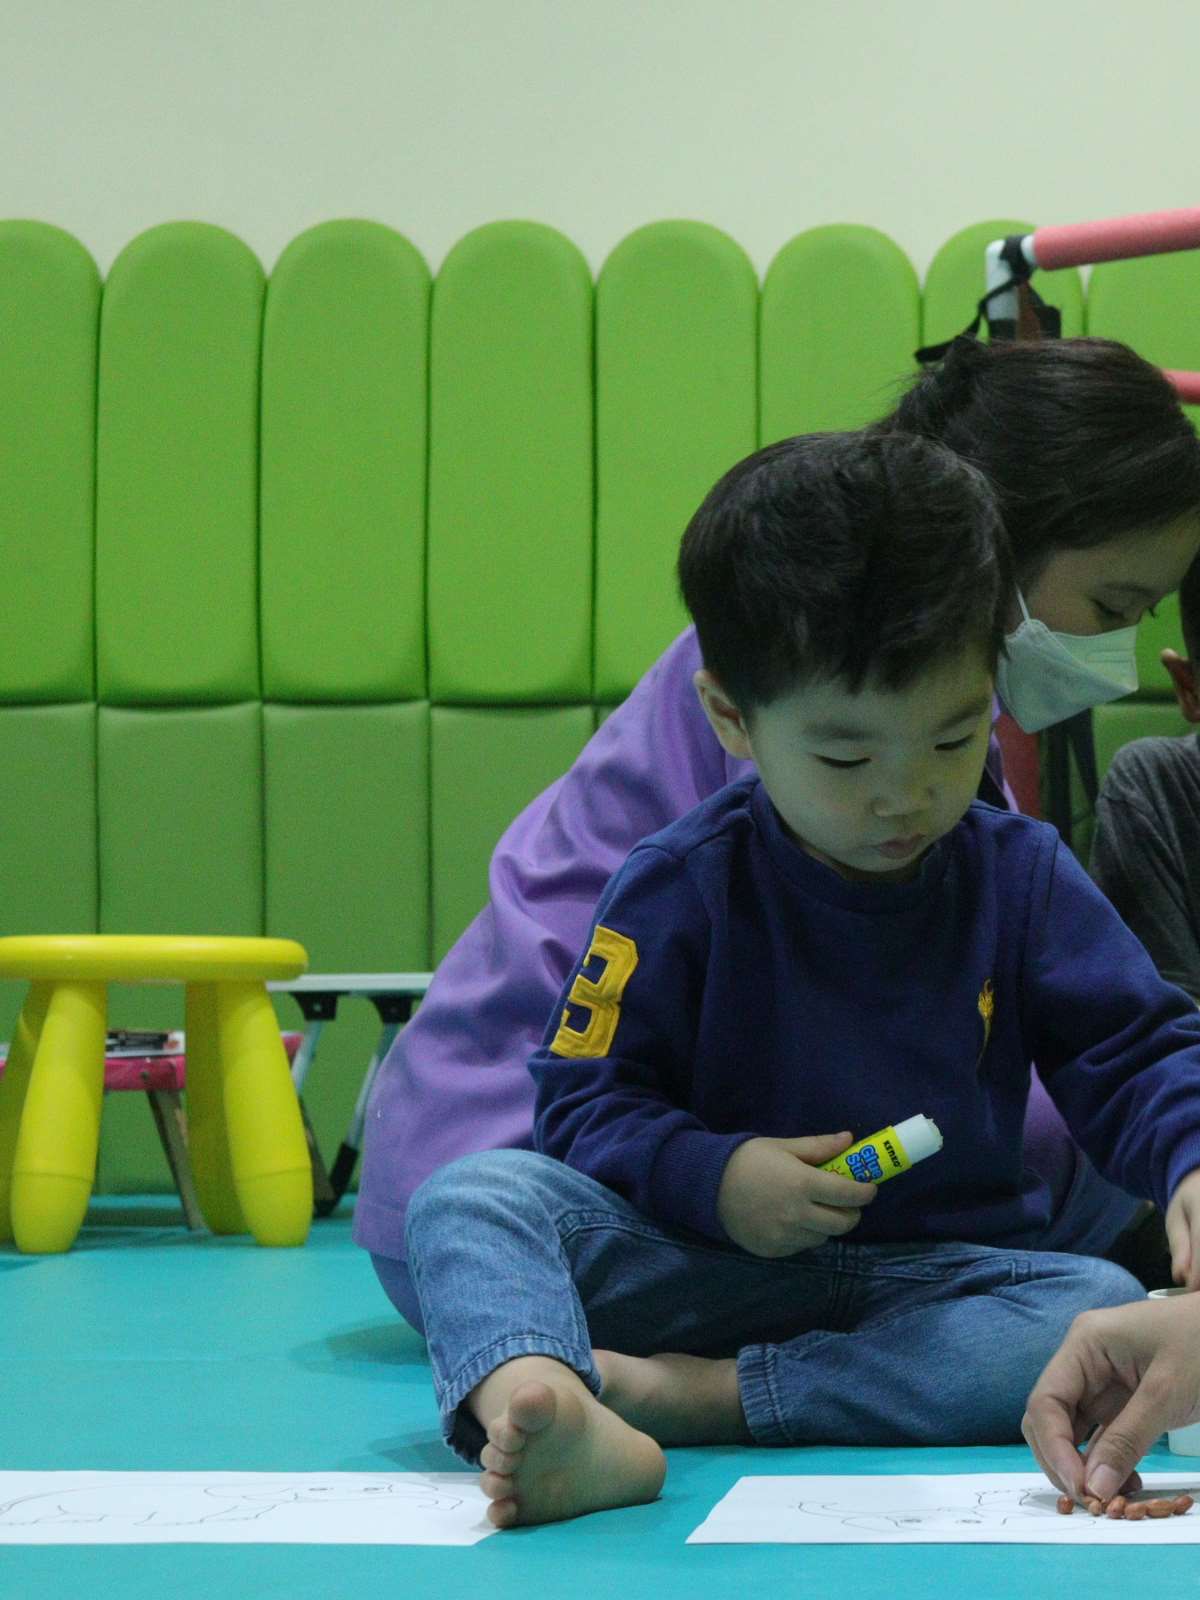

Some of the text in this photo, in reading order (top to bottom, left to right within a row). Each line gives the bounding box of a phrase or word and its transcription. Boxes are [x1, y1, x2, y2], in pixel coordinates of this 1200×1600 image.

[550, 925, 640, 1059] 3
[846, 1152, 872, 1183] Stic
[860, 1145, 883, 1179] Glue
